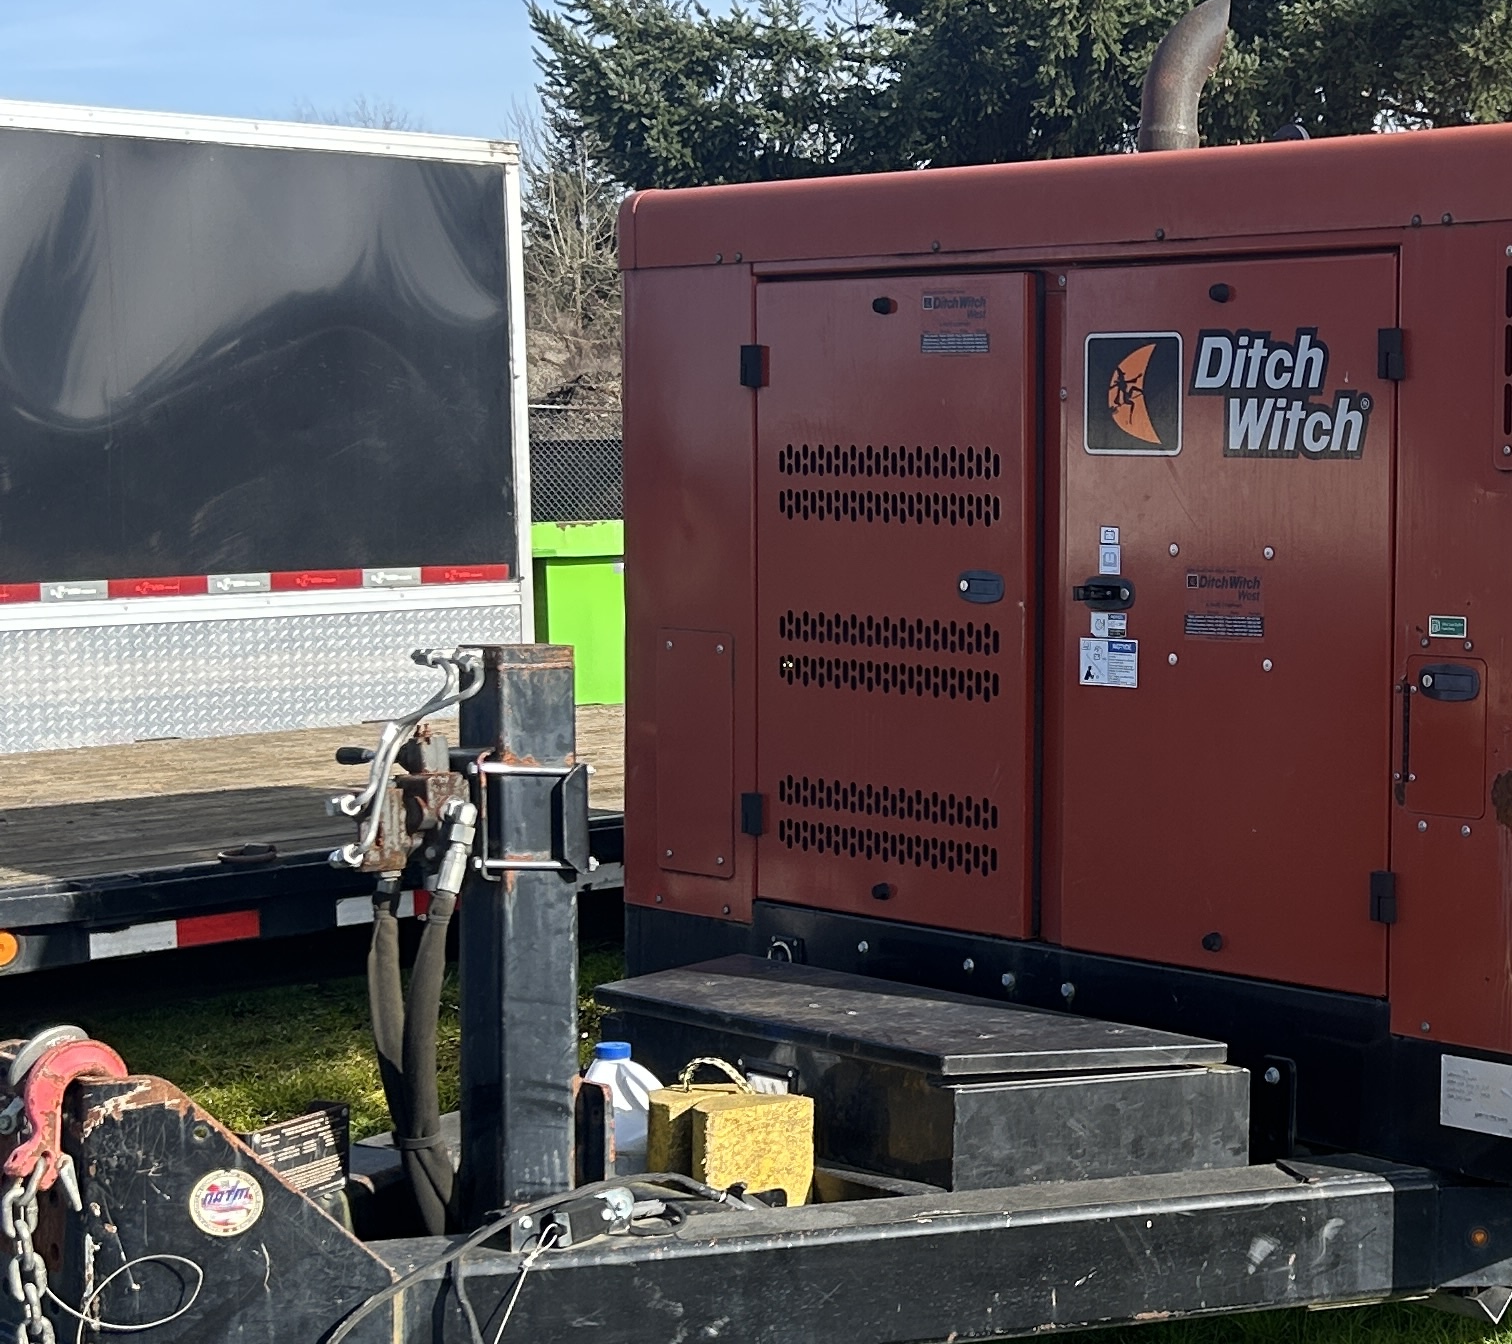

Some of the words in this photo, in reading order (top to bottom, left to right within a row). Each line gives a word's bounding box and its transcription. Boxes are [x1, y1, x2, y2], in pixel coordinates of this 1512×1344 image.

[933, 296, 959, 309] Ditch
[959, 296, 986, 309] Witch
[1194, 334, 1325, 390] Ditch
[1229, 397, 1364, 452] Witch
[1199, 575, 1228, 589] Ditch
[1229, 575, 1260, 589] Witch
[1238, 590, 1260, 601] West
